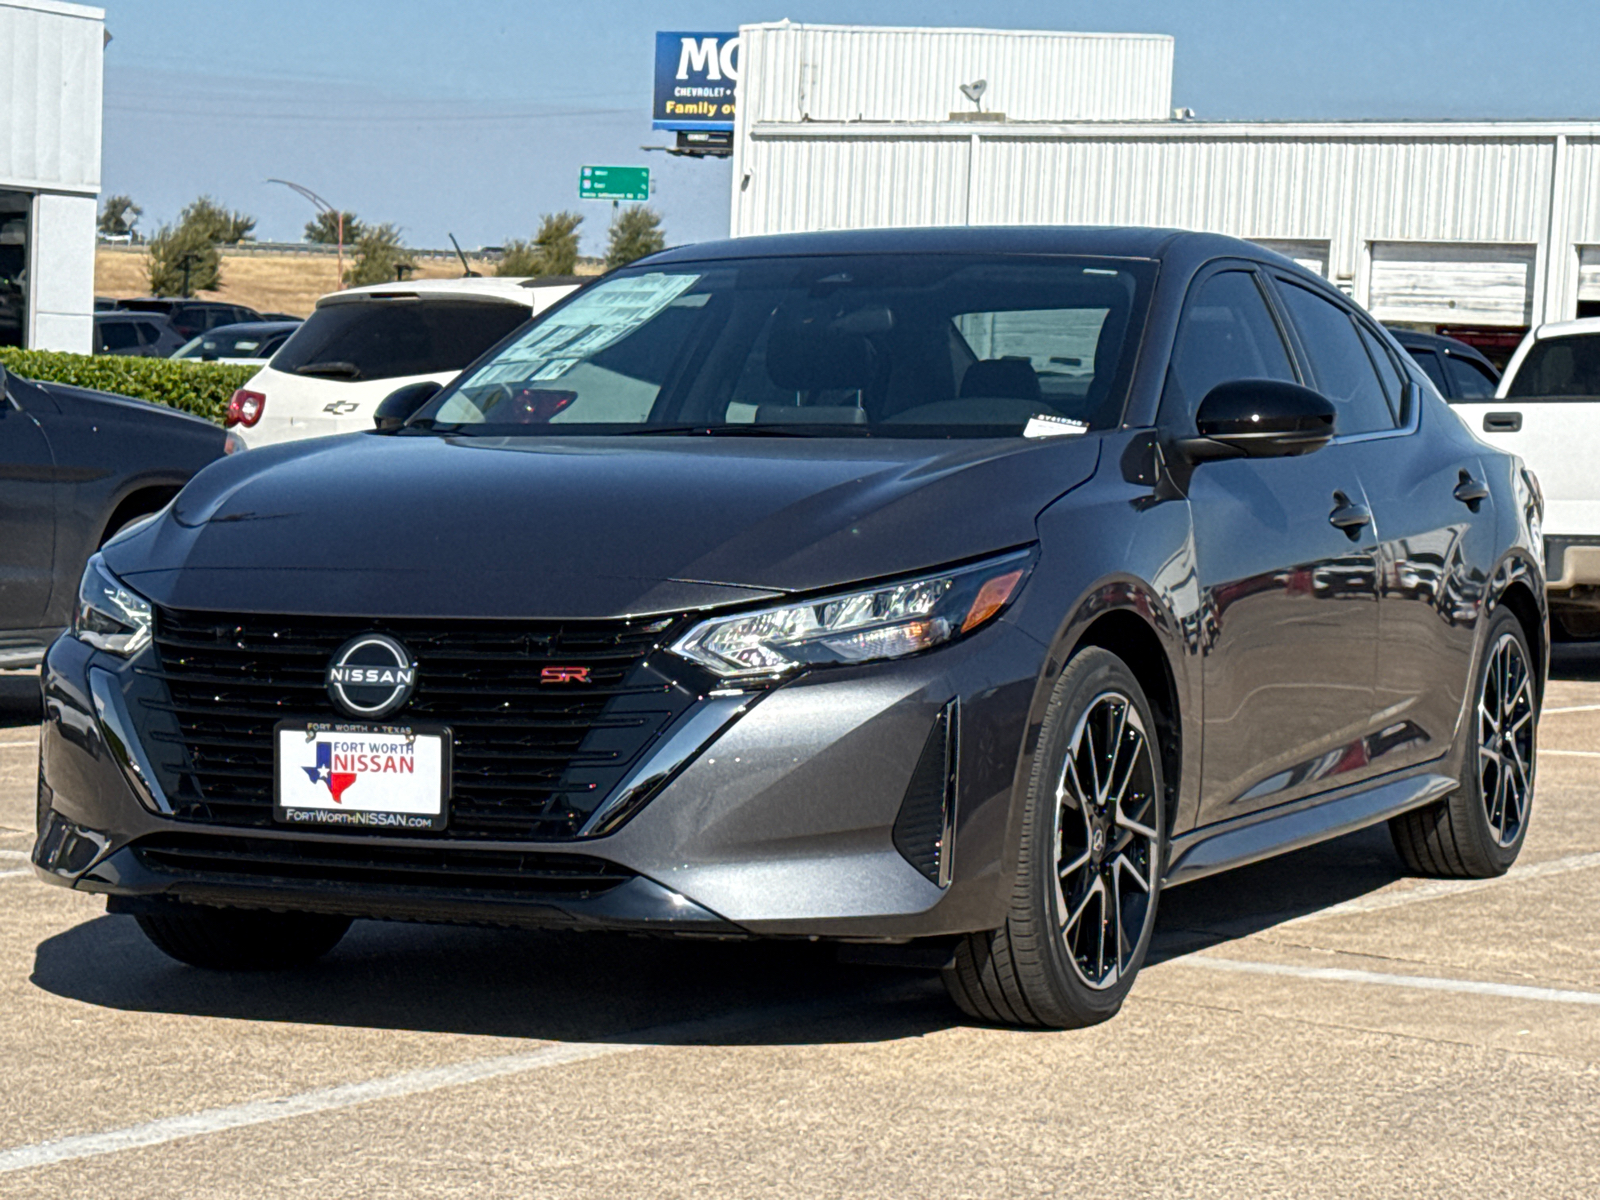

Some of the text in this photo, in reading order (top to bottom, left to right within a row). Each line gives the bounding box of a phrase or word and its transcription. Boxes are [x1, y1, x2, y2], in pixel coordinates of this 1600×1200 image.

[674, 86, 725, 97] CHEVROLET
[666, 100, 717, 117] Family
[330, 667, 412, 684] NISSAN
[539, 666, 591, 684] SR
[306, 722, 412, 735] FORT WORTH TEXAS
[333, 741, 414, 755] FORT WORTH
[333, 754, 414, 774] NISSAN
